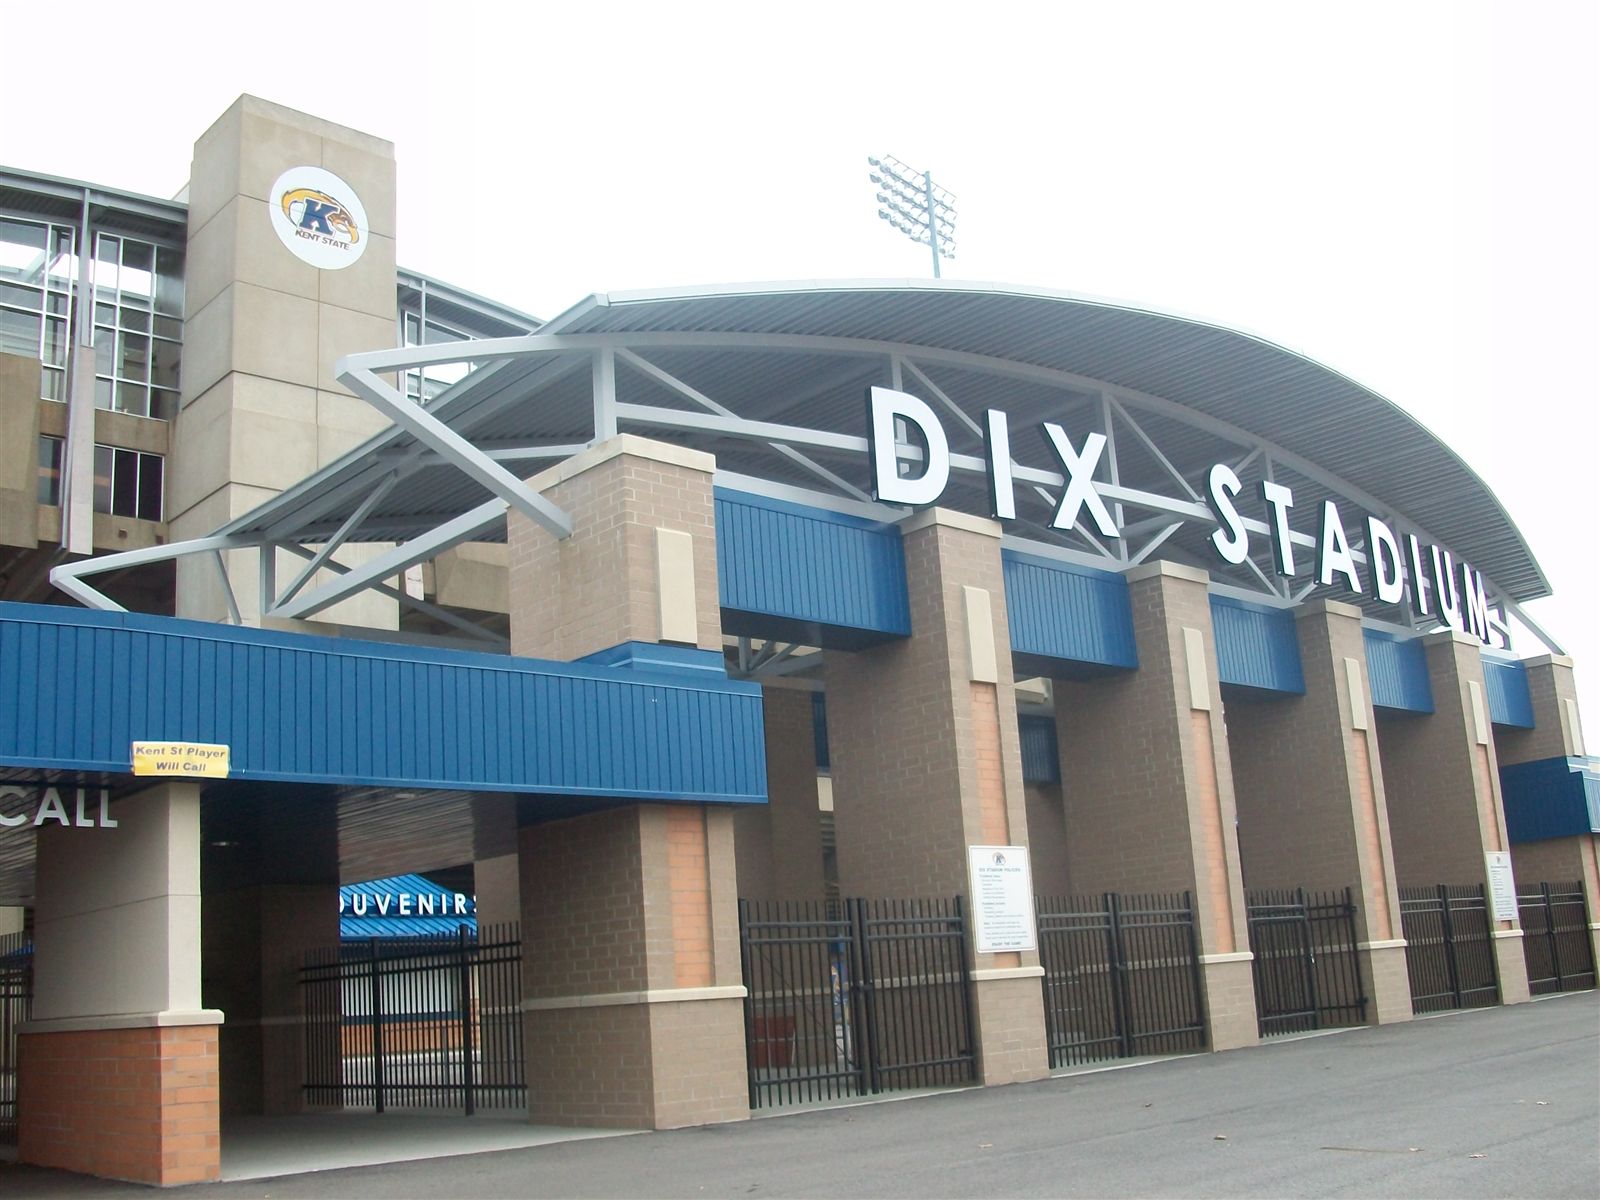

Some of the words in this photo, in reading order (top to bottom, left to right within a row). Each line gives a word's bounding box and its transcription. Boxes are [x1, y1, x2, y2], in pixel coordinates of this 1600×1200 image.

[295, 230, 320, 242] KENT
[321, 237, 350, 250] STATE
[867, 384, 1121, 539] DIX
[1207, 463, 1504, 648] STADIUM
[135, 746, 166, 755] Kent
[170, 746, 182, 755] St
[186, 747, 226, 759] Player
[156, 762, 179, 771] Will
[182, 762, 207, 772] Call
[0, 785, 118, 828] CALL
[340, 893, 477, 915] UVENIR
